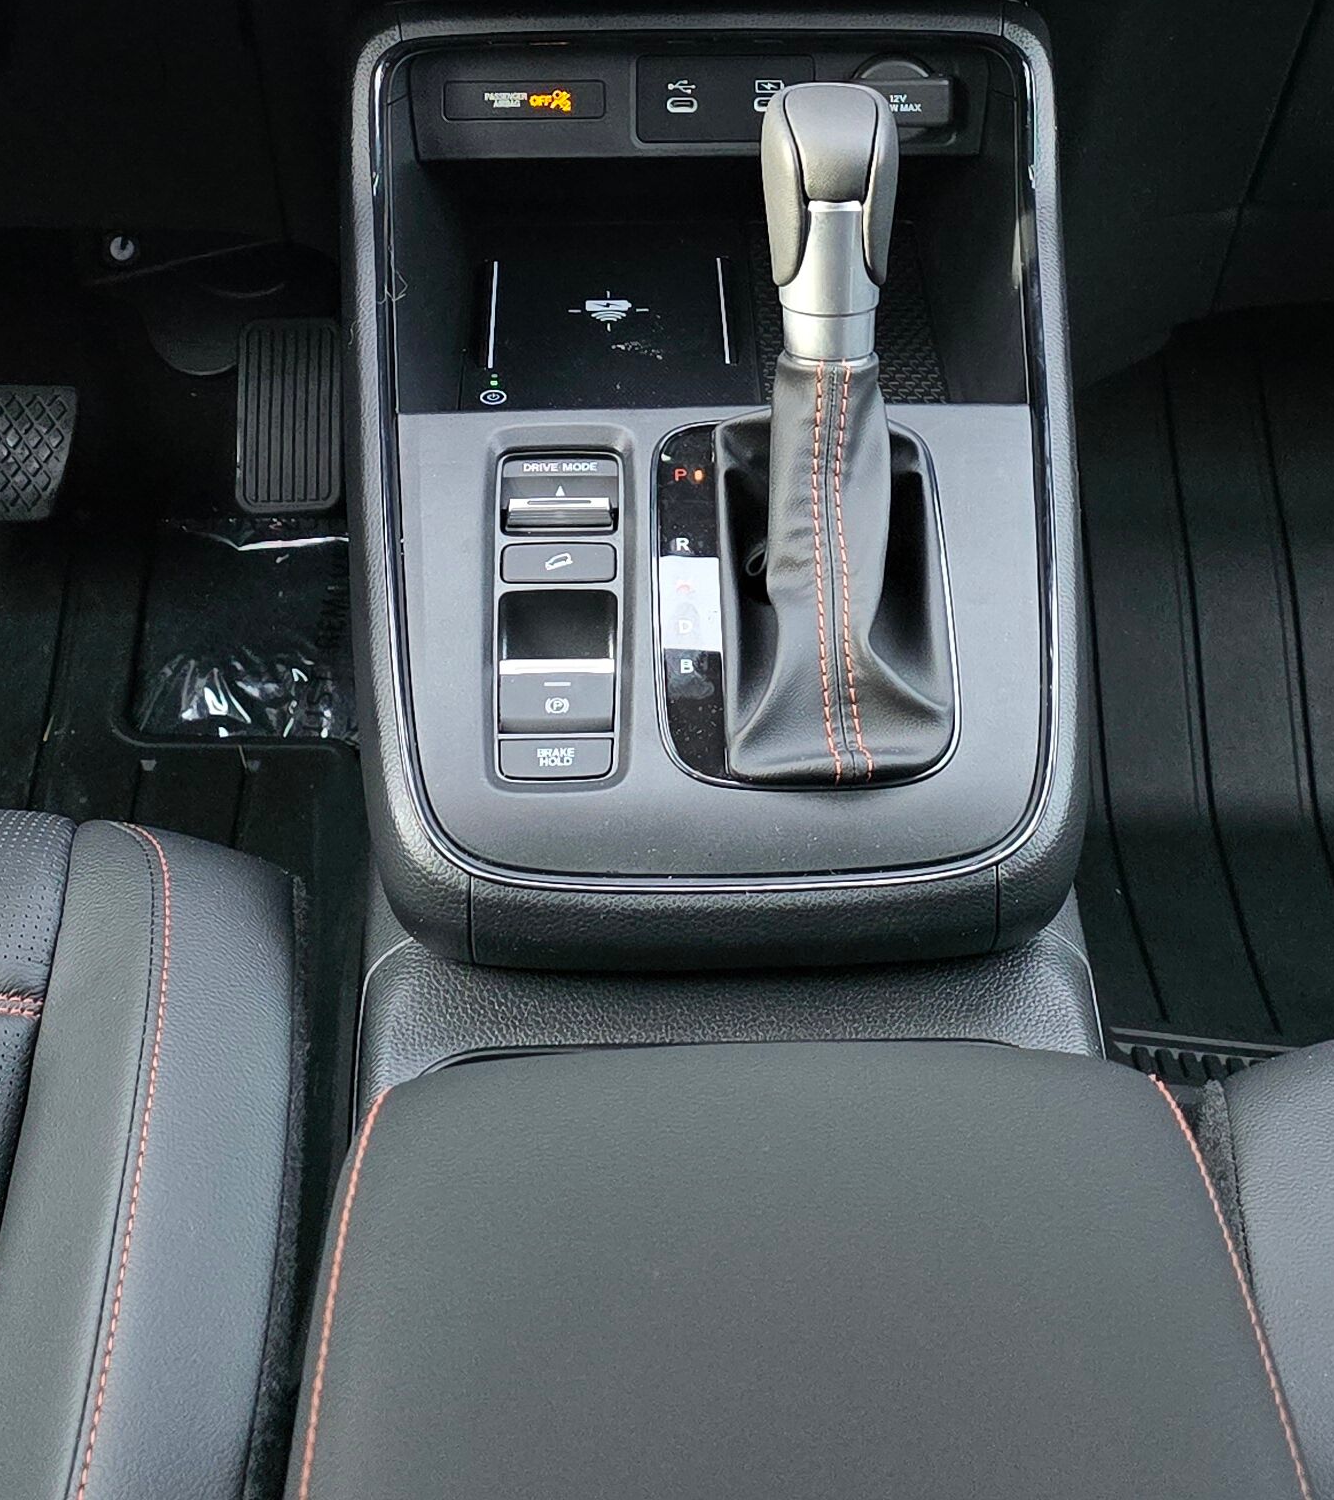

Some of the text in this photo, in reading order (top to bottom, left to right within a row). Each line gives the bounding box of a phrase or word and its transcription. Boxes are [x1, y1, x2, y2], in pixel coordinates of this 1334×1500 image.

[528, 94, 552, 108] OFF
[889, 94, 907, 103] 12V
[900, 103, 922, 112] MAX
[523, 462, 598, 472] DRIVE MODE
[674, 468, 687, 482] P
[675, 537, 690, 551] R
[678, 619, 693, 634] D
[680, 659, 694, 674] B
[536, 748, 575, 757] BRAKE
[539, 757, 573, 767] HOLD
